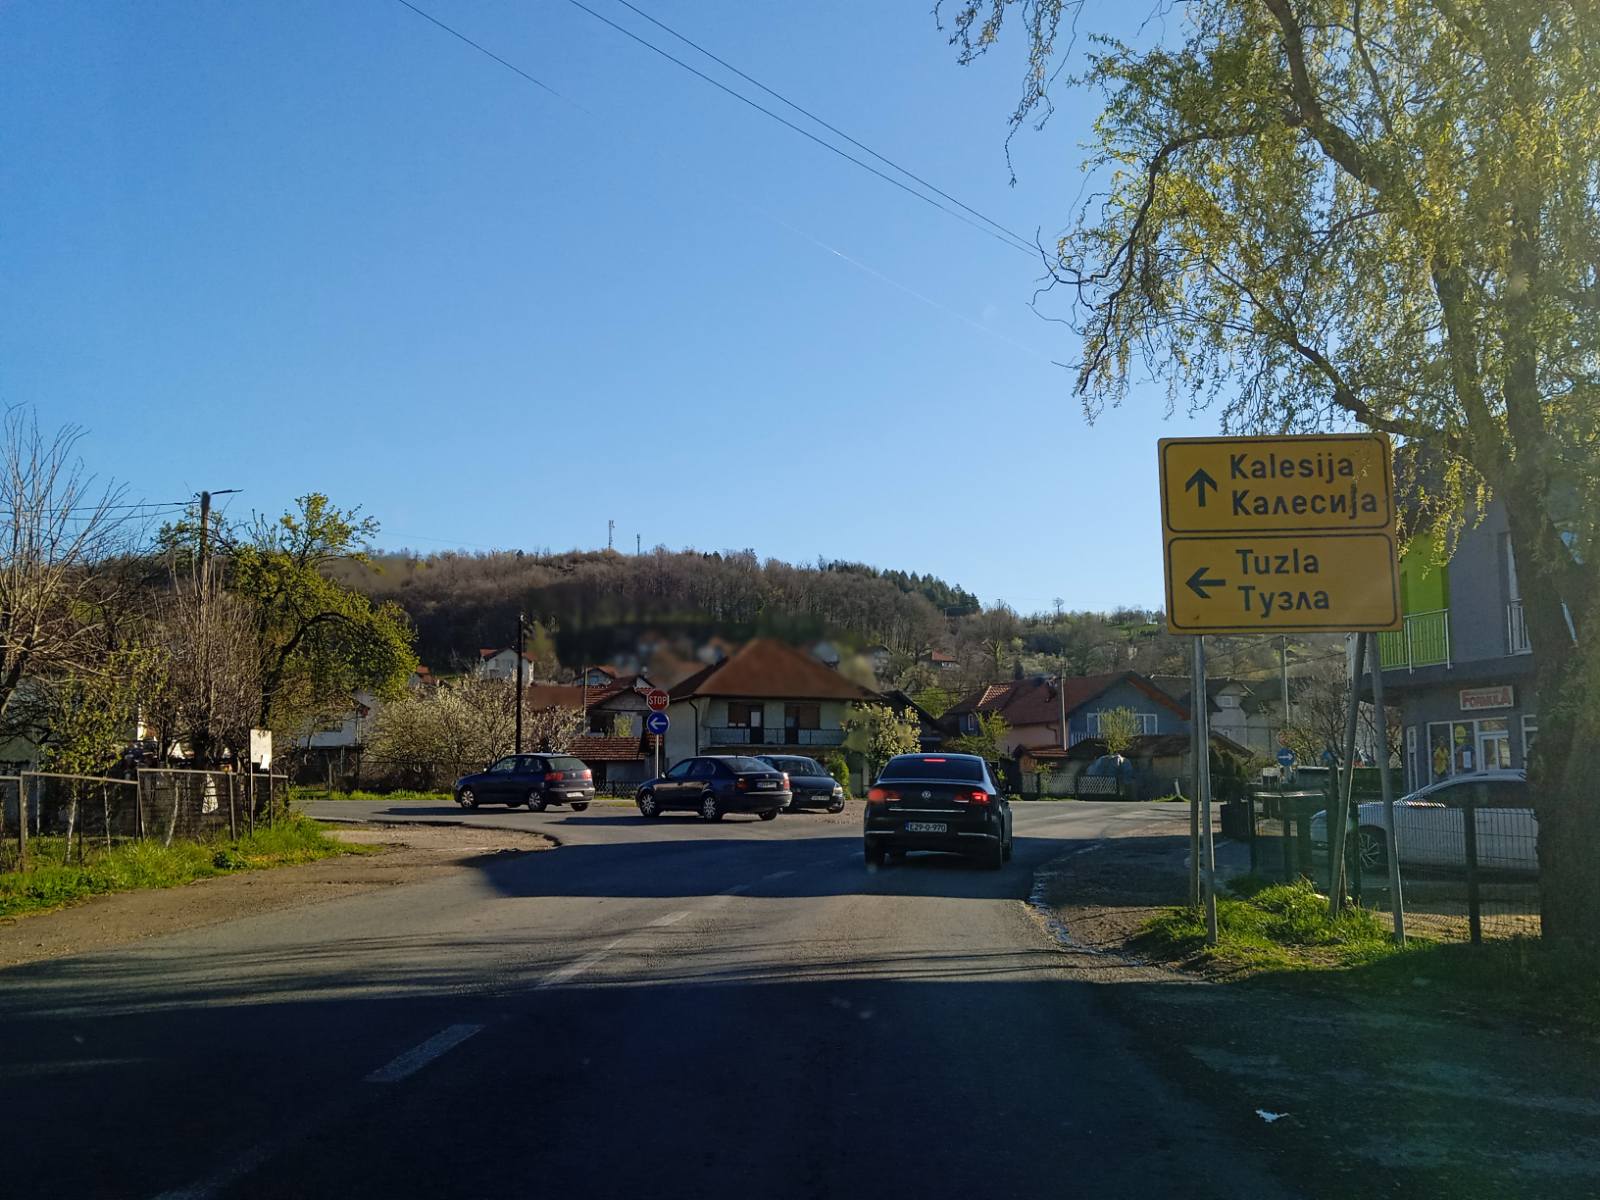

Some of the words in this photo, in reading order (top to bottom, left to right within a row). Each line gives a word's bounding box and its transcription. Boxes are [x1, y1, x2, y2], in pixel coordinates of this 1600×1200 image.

[1230, 453, 1354, 484] Kalesija
[1232, 485, 1378, 520] Калесија
[1235, 548, 1320, 576] Tuzla
[1238, 585, 1330, 618] Тузла
[648, 695, 667, 705] STOP
